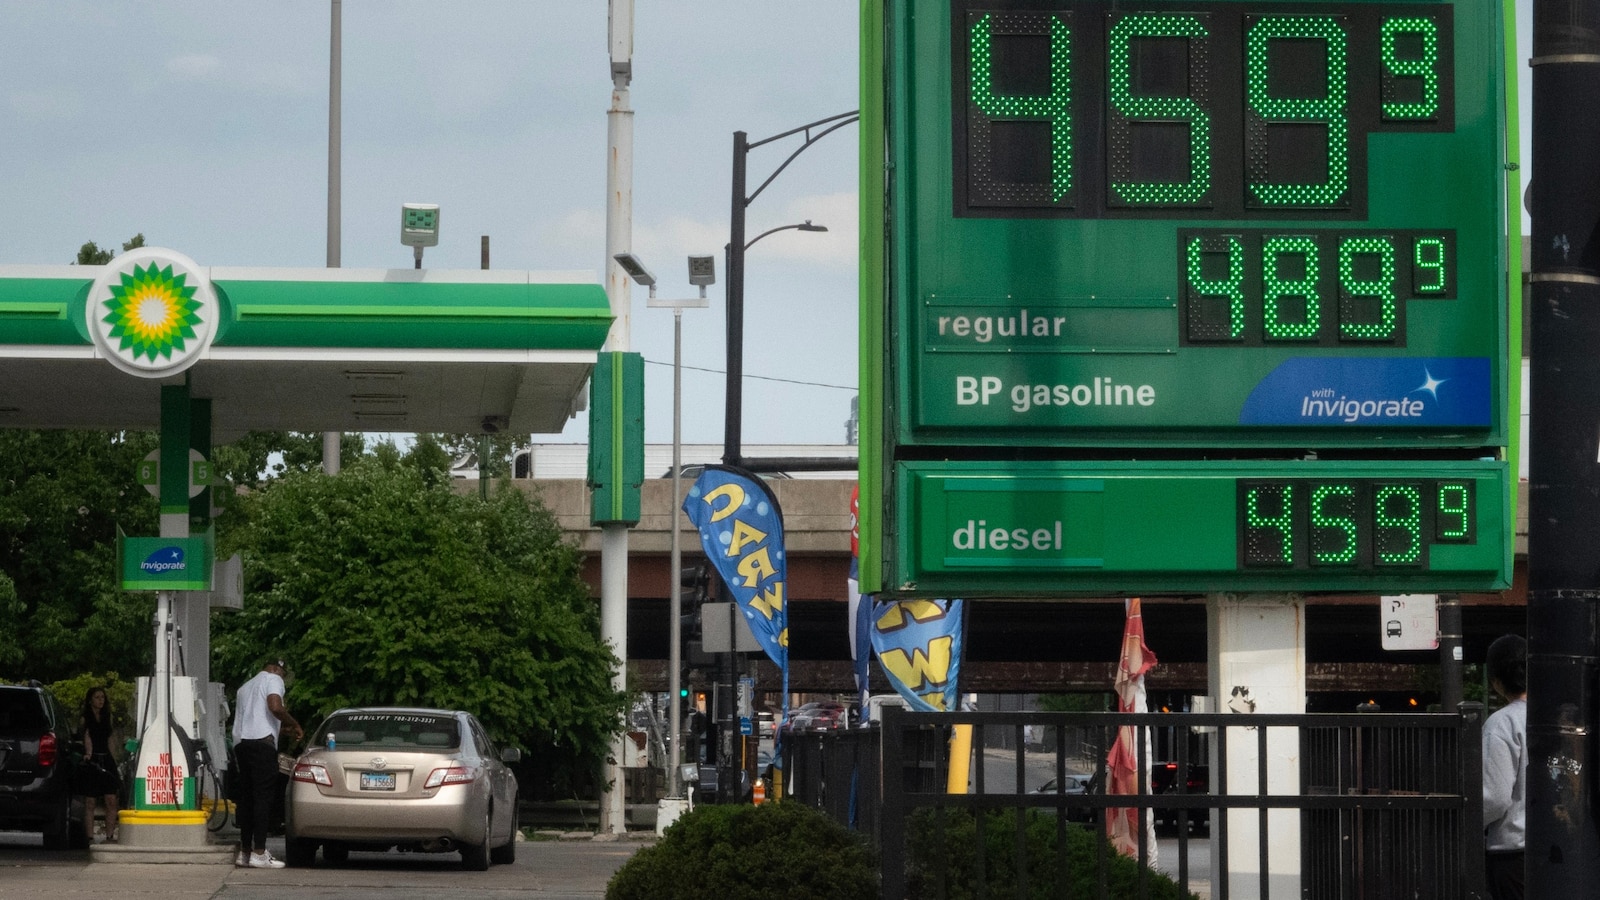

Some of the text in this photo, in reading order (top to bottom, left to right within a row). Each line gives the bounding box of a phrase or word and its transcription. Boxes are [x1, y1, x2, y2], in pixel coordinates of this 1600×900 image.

[937, 311, 1066, 343] regular
[956, 376, 1156, 413] BP gasoline
[1312, 387, 1335, 398] with
[1301, 396, 1425, 423] Invigorate
[141, 465, 150, 479] 6
[198, 465, 207, 479] 5
[952, 520, 1062, 551] diesel
[140, 561, 185, 571] Invigorate
[159, 753, 171, 766] NO
[147, 765, 183, 779] SMOKNG
[146, 778, 167, 791] TURN
